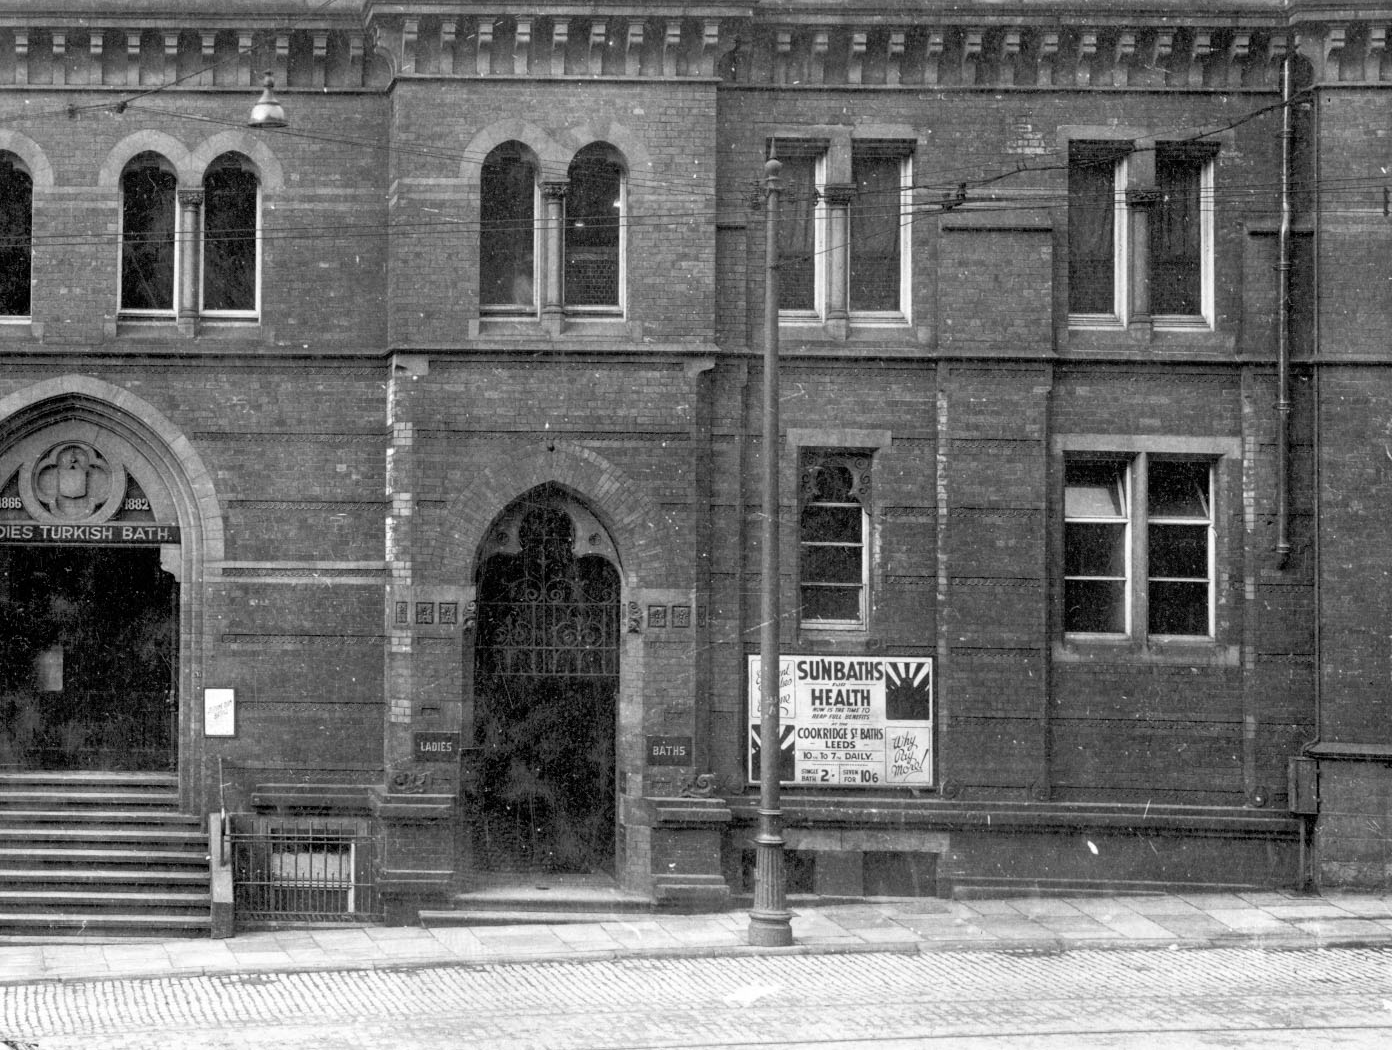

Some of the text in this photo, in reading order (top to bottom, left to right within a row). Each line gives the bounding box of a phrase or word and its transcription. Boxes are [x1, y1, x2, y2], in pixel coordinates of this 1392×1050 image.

[124, 498, 150, 510] 1882
[39, 525, 113, 540] TURKISH
[122, 526, 173, 540] BATH.
[797, 659, 884, 681] SUNBATHS
[811, 688, 870, 707] HEALTH
[797, 727, 848, 740] COOKRIDGE
[860, 728, 884, 740] BATHS
[420, 741, 452, 752] LADIES
[825, 740, 856, 749] LEEDS
[891, 731, 918, 751] Why
[652, 746, 686, 756] BATHS
[895, 748, 917, 764] Pay
